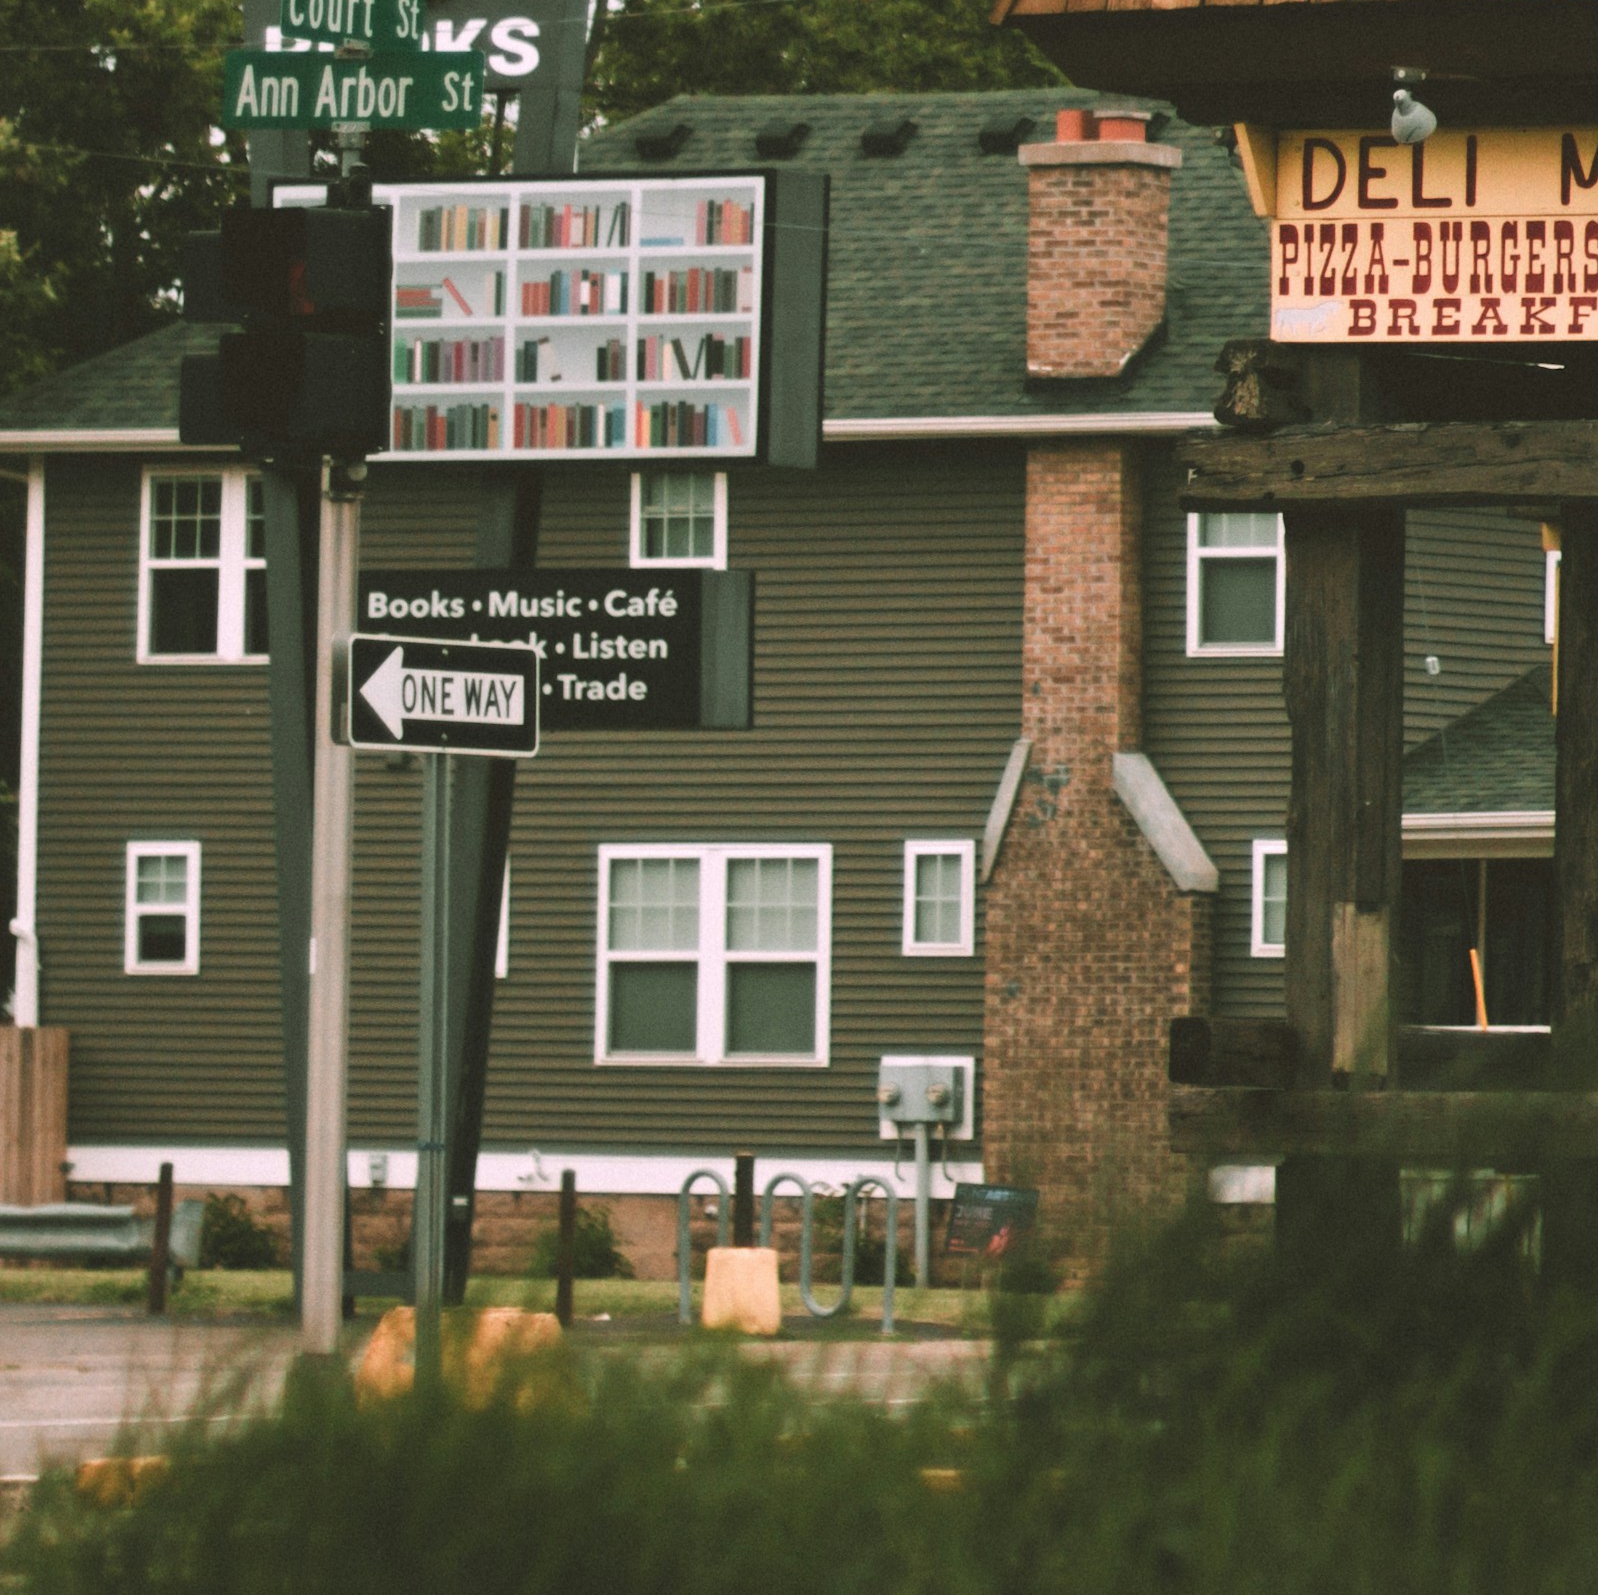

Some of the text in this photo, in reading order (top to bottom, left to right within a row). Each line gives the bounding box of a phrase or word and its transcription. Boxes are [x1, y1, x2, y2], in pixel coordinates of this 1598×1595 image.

[235, 64, 474, 118] Ann Arbor St
[1301, 134, 1476, 211] DELI
[367, 587, 678, 619] Books Music Café
[573, 631, 668, 660] Listen
[402, 673, 517, 719] ONE WAY
[557, 672, 647, 700] Trade
